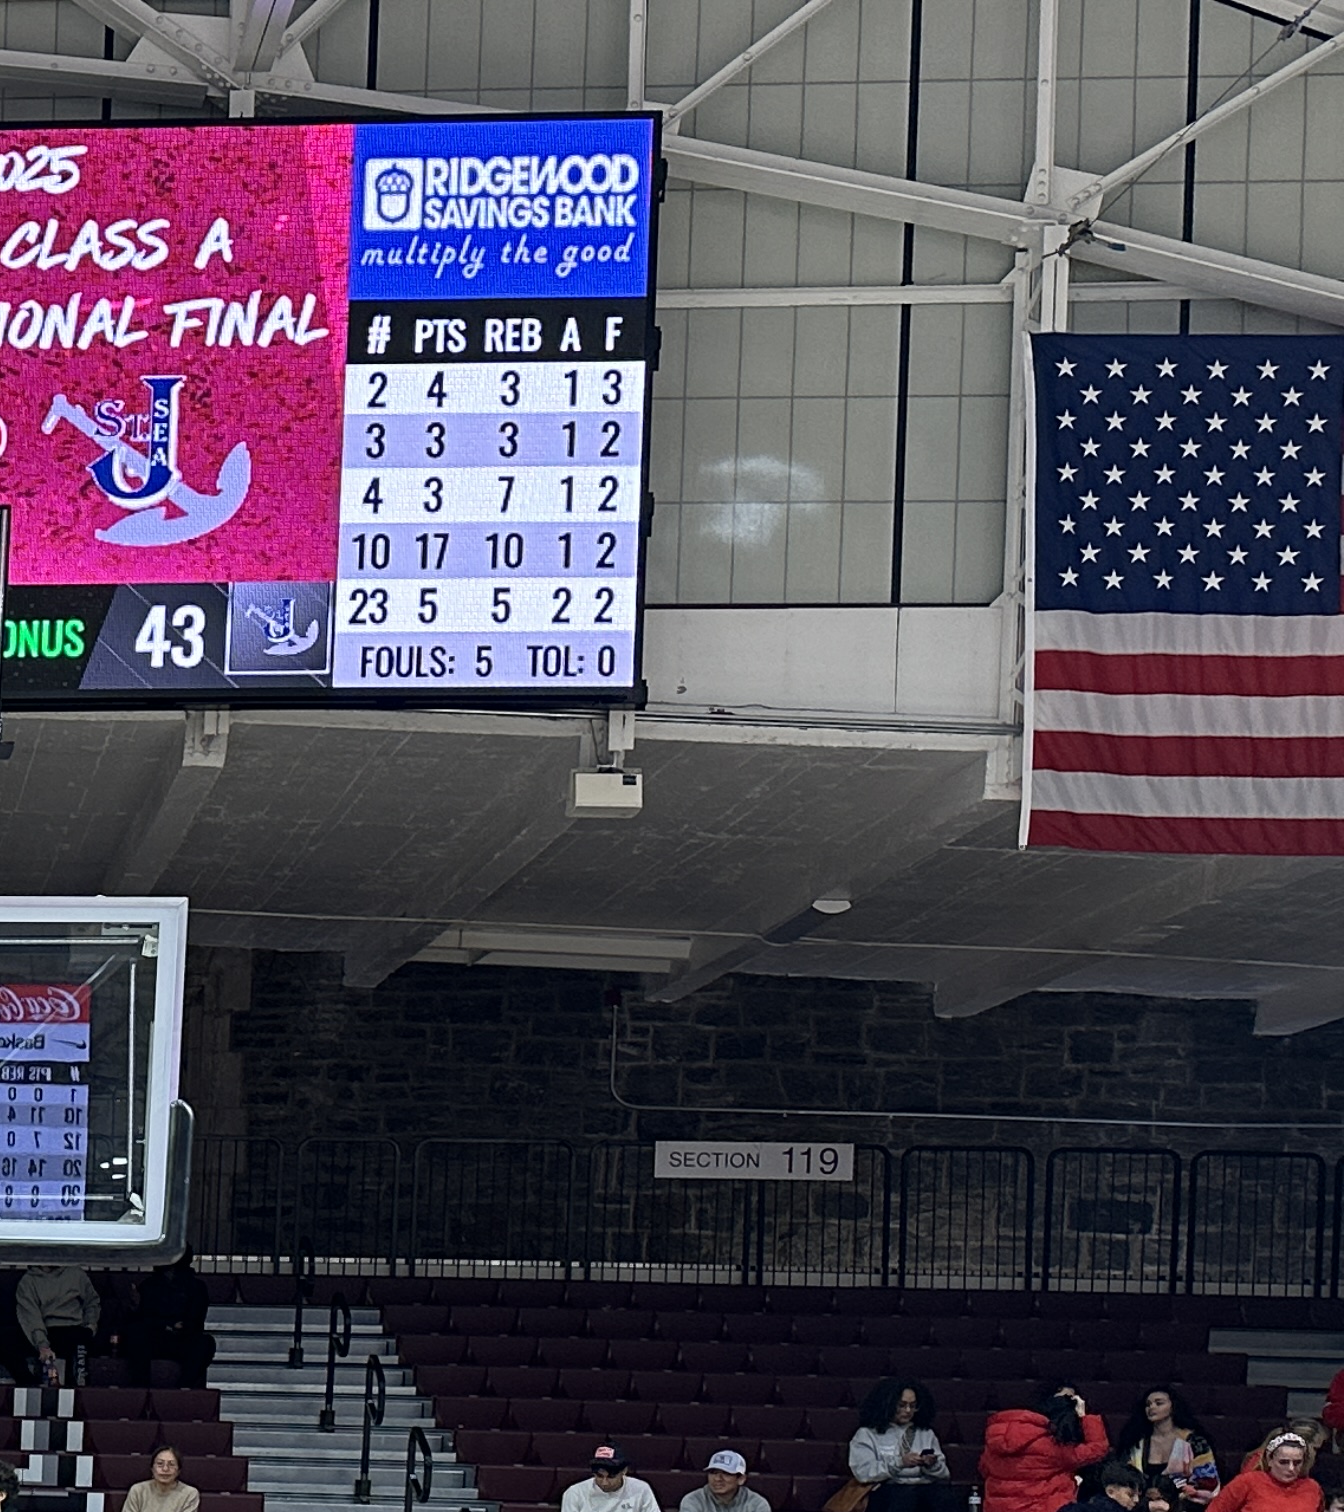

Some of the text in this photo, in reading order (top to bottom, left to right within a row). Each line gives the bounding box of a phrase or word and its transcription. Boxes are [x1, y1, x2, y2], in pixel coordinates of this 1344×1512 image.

[426, 155, 638, 195] RIDGEWOOD
[424, 195, 636, 228] SAVINGS BANK
[1, 219, 168, 271] CLASS
[195, 218, 233, 268] A
[361, 233, 635, 279] multiply the good
[164, 290, 328, 347] FINAL
[368, 315, 623, 353] # PTS REB A F
[369, 370, 621, 407] 2 4 3 1 3
[353, 533, 616, 569] 10 17 10 1 2
[349, 588, 613, 624] 23 5 5 2 2
[135, 605, 205, 668] 43
[361, 646, 492, 677] FOULS: 5
[528, 646, 615, 676] TOL: 0
[669, 1147, 839, 1174] SECTION 119
